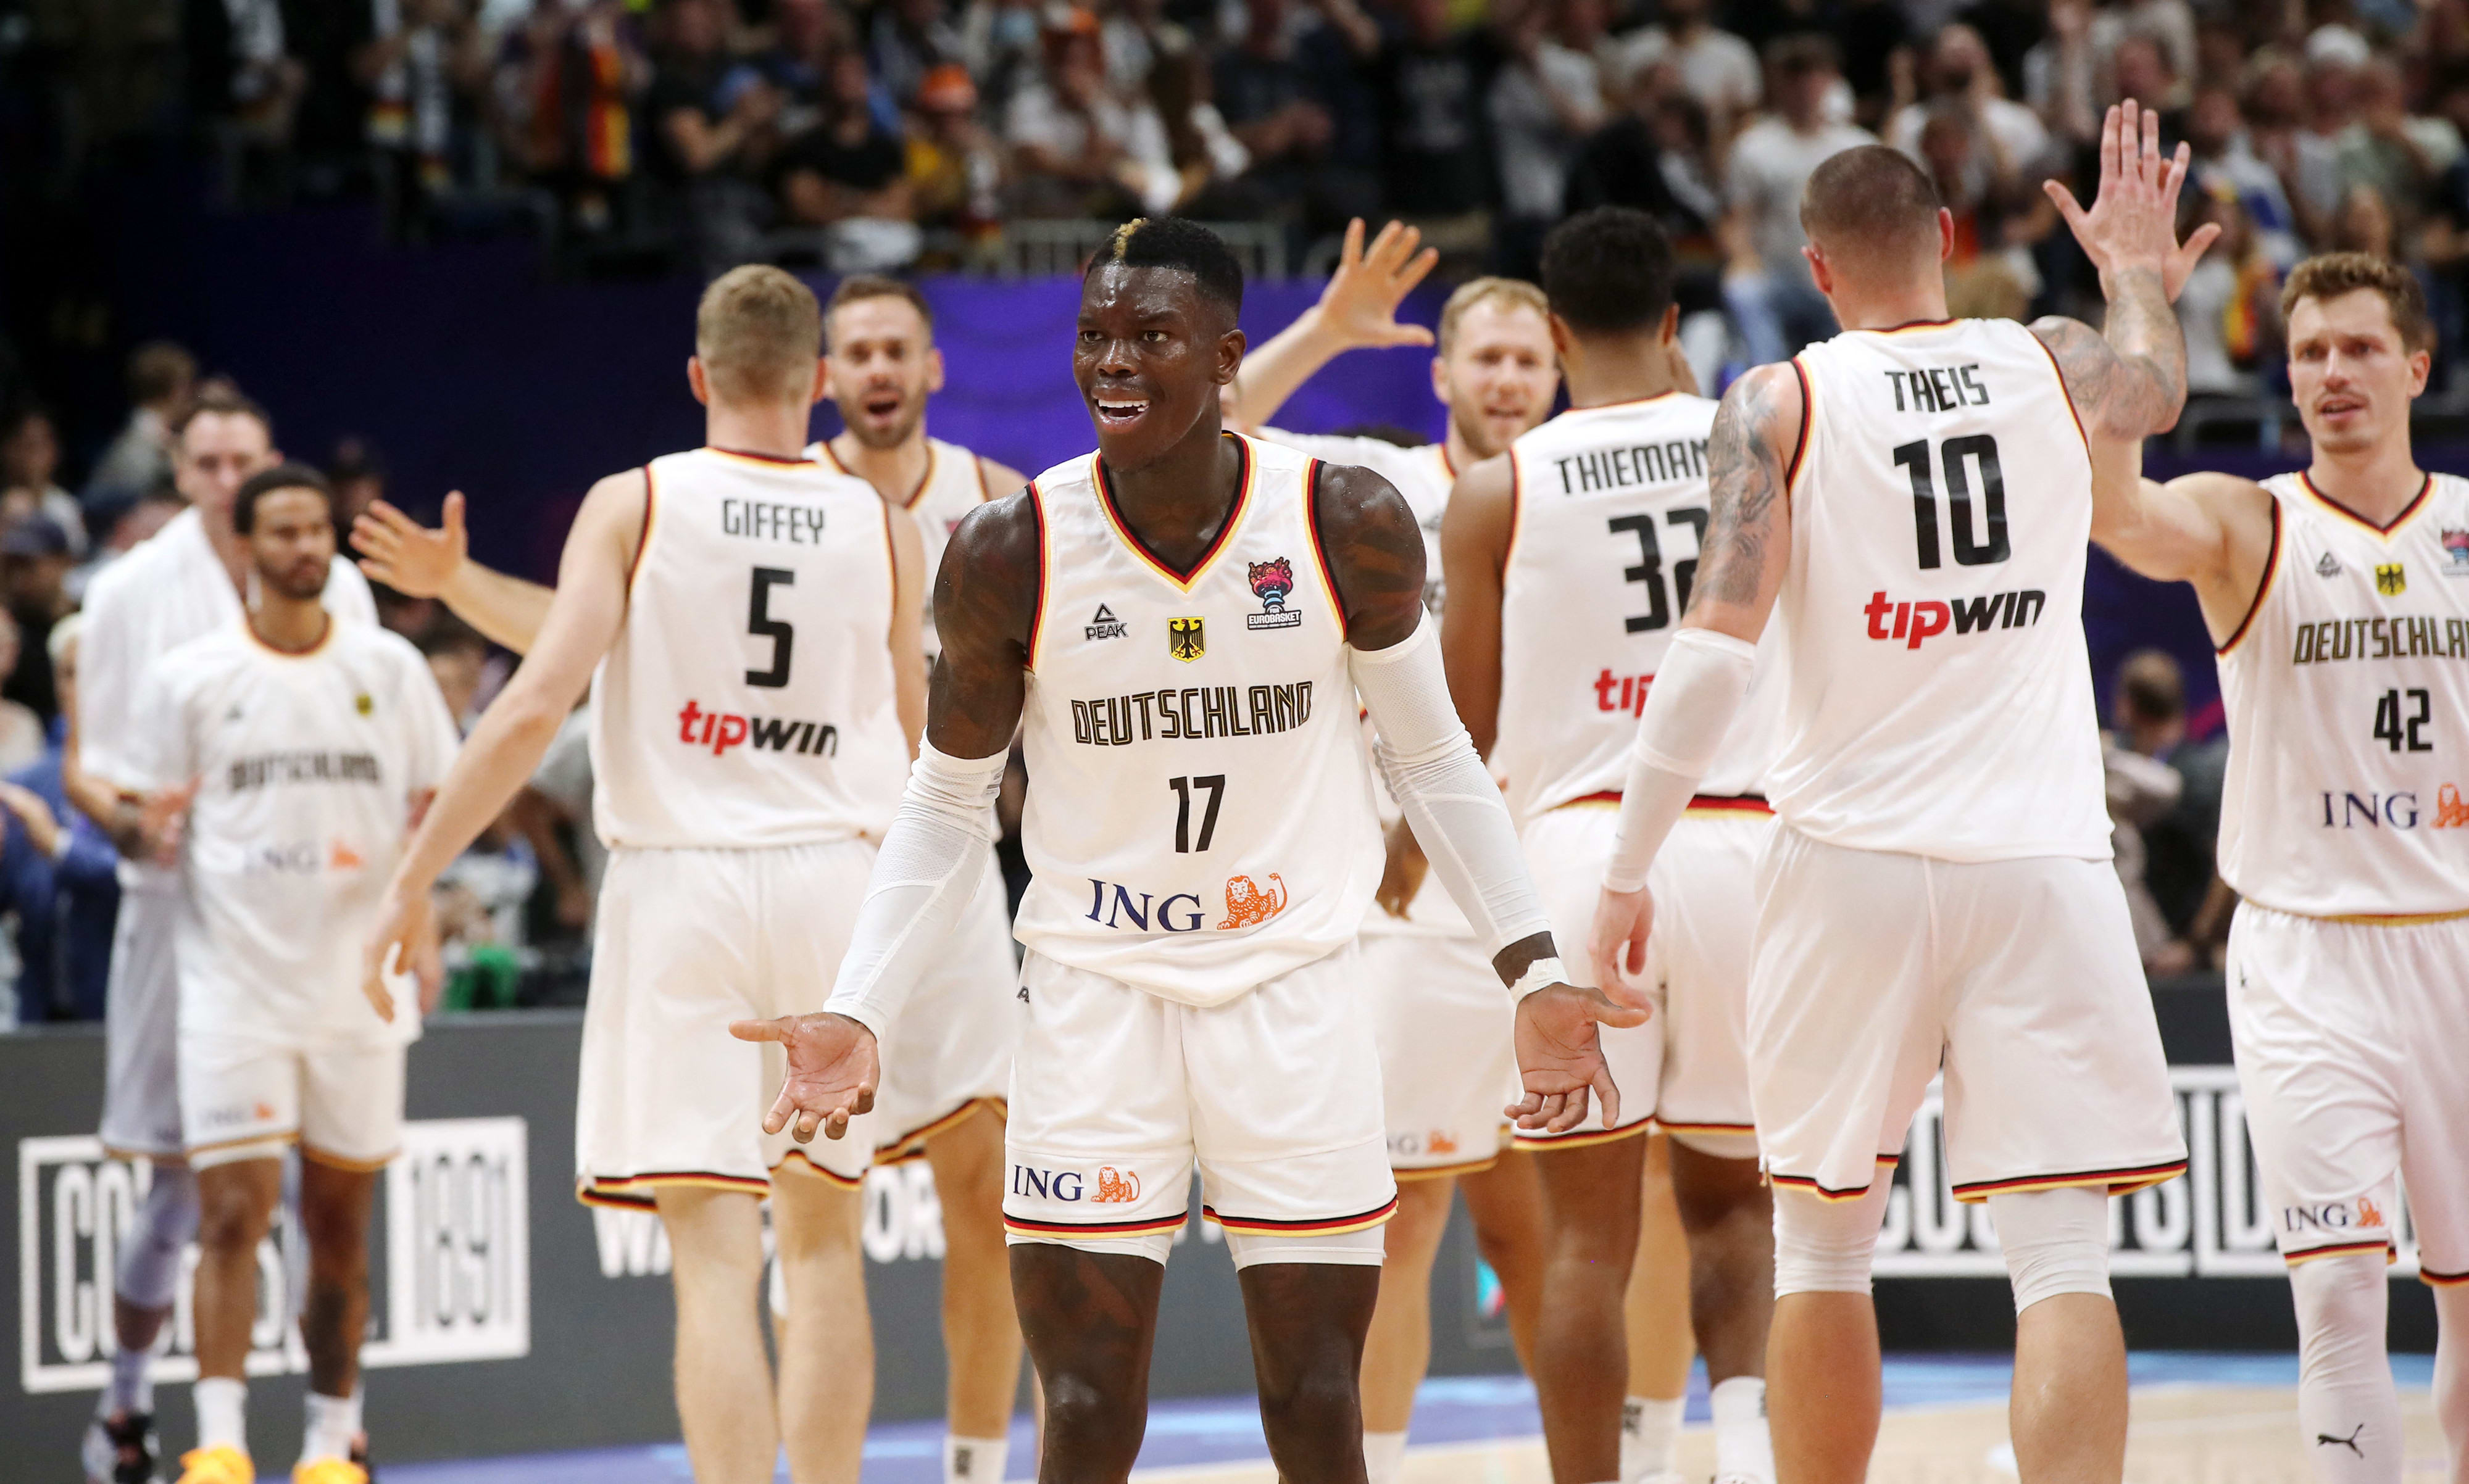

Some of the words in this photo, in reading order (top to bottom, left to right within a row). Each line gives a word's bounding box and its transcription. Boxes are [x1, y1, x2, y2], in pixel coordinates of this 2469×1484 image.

[1884, 363, 1990, 412] THEIS
[722, 498, 825, 544] GIFFEY
[1892, 434, 2011, 570] 10
[1607, 507, 1709, 633] 32
[744, 566, 794, 688] 5
[1085, 622, 1129, 640] PEAK
[1248, 610, 1301, 625] EUROBASKET
[1863, 590, 2046, 650] tipwin
[2292, 616, 2469, 666] DEUTSCHLA
[678, 700, 838, 758] tipwin
[1071, 681, 1313, 747] DEUTSCHLAND
[2373, 688, 2433, 754] 42
[1168, 774, 1226, 854] 17
[2321, 791, 2419, 829] ING
[1085, 877, 1205, 932] ING
[1013, 1164, 1085, 1202] ING
[2284, 1203, 2347, 1232] ING
